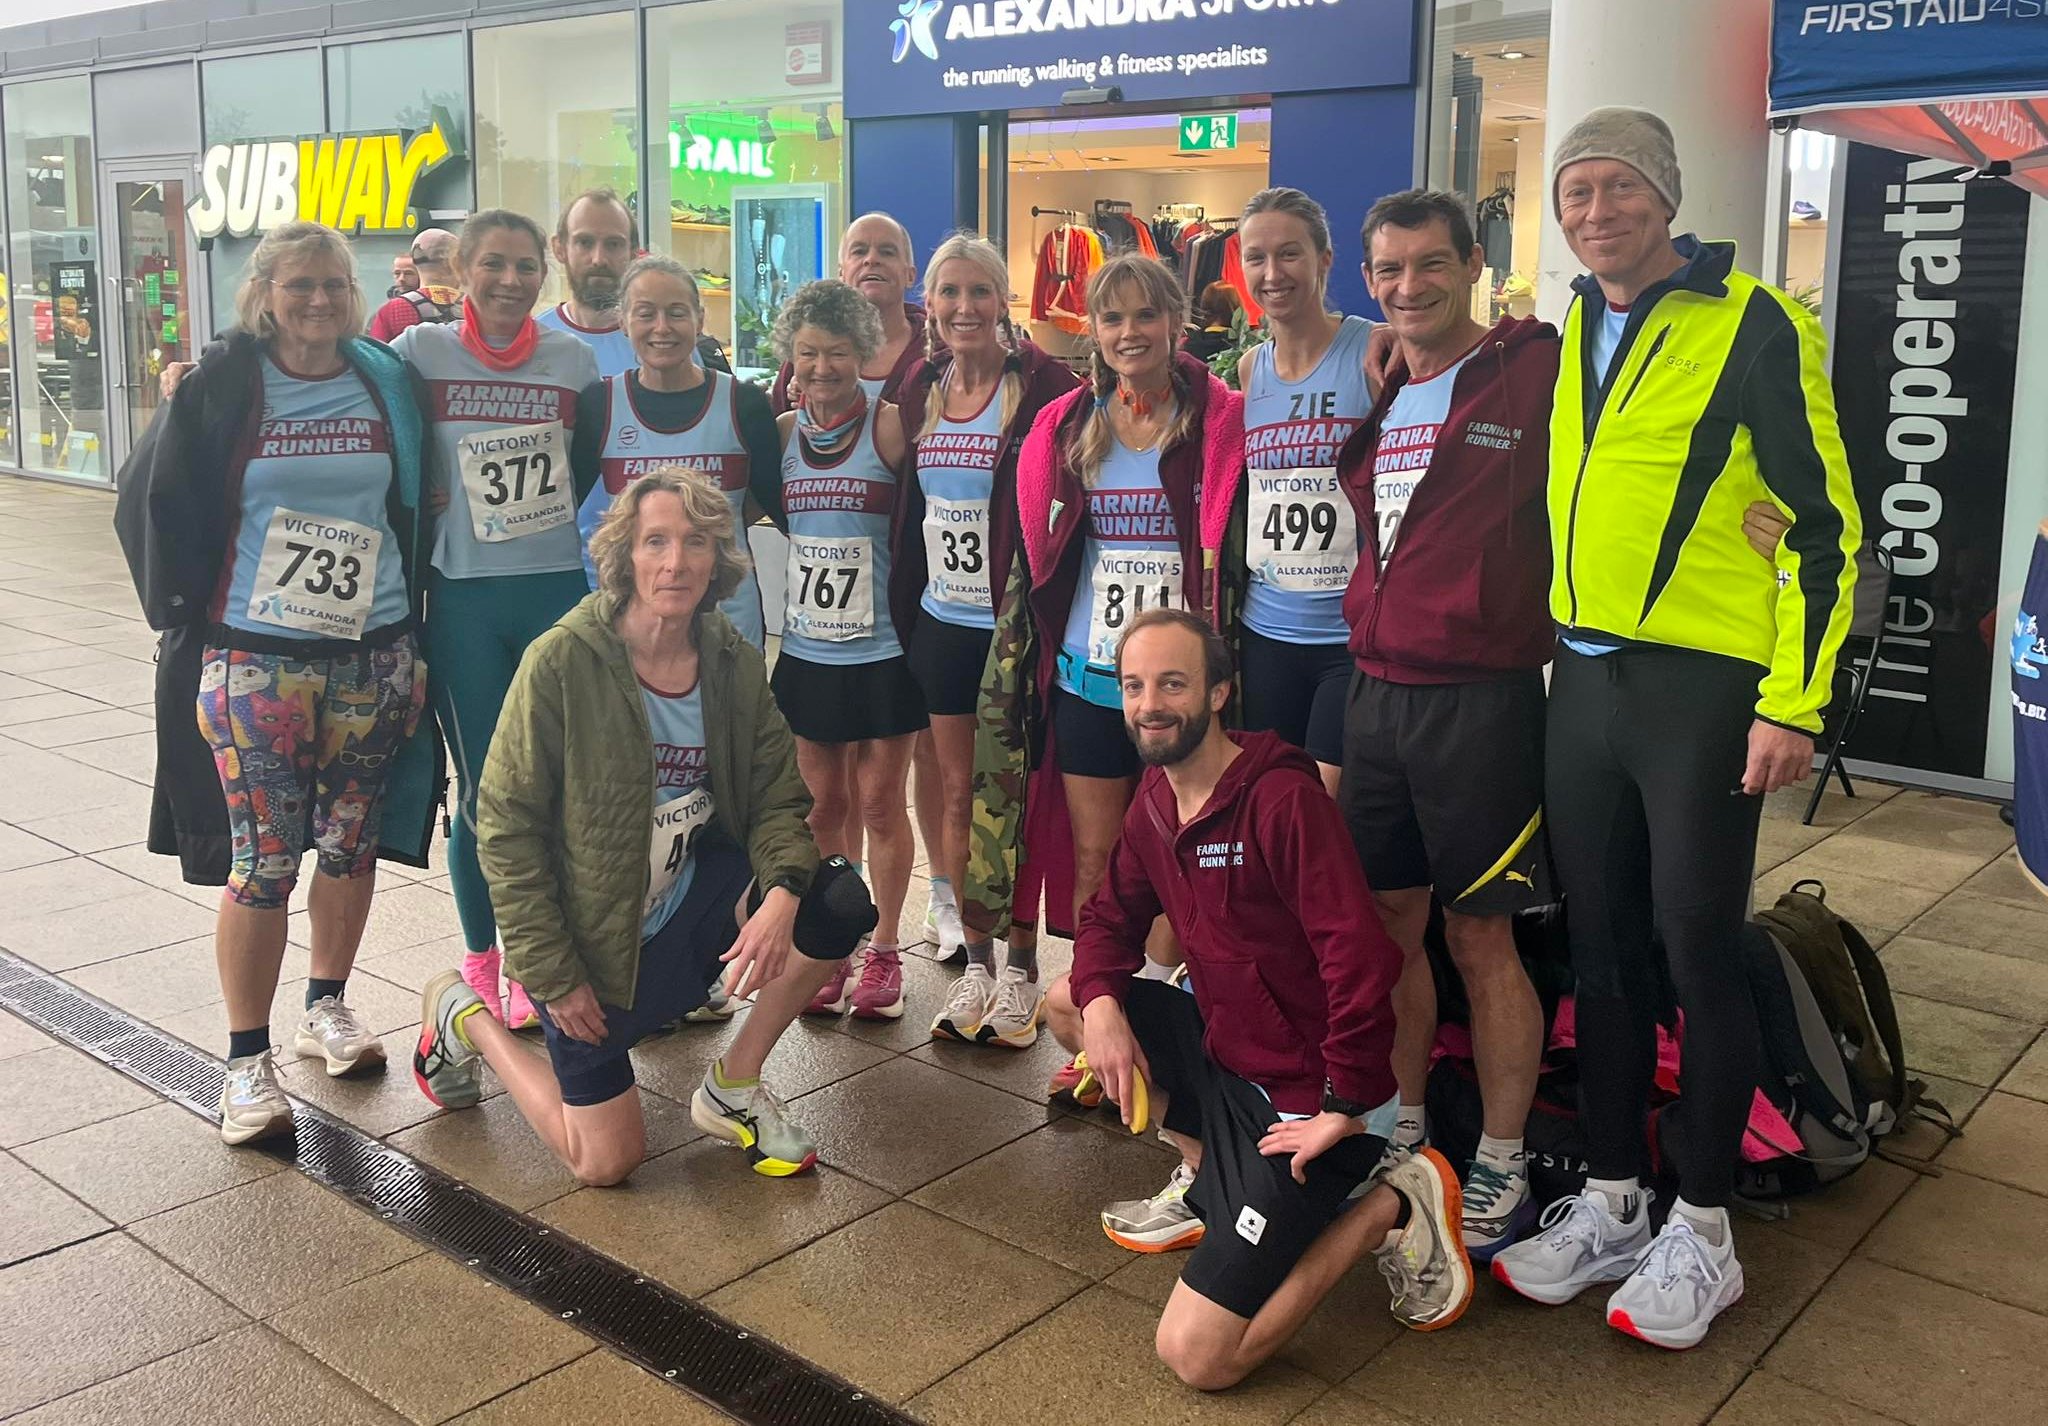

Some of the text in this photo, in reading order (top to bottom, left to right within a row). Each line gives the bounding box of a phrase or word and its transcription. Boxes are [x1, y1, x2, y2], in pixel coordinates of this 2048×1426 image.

[945, 0, 1196, 39] ALEXANDRA
[1800, 0, 2048, 35] FIRSTAID4S
[943, 44, 1268, 88] the running, walking & fitness specialists
[1667, 355, 1700, 371] GORE
[447, 384, 559, 405] FARNHAM
[447, 401, 558, 420] RUNNERS
[1288, 391, 1336, 421] ZIE
[258, 420, 371, 437] FARNHAM
[262, 437, 372, 456] RUNNERS
[468, 432, 552, 455] VICTORY 5
[917, 452, 995, 468] RUNNERS
[1374, 449, 1434, 474] RUNNER
[480, 452, 557, 506] 372
[785, 479, 867, 496] FARNHAM
[1260, 478, 1338, 492] VICTORY 5
[787, 495, 865, 511] RUNNERS
[1090, 493, 1172, 514] ARNHA
[505, 504, 567, 525] ALEXANDRA
[539, 513, 569, 528] SPORTS
[934, 505, 983, 522] VICTORY
[284, 518, 371, 550] VICTORY 5
[1091, 516, 1178, 536] RUNNER
[1262, 501, 1338, 551] 499
[852, 547, 861, 559] 5
[942, 530, 983, 574] 33
[275, 541, 362, 601] 733
[1102, 560, 1180, 576] VICTORY 5
[1276, 565, 1349, 575] ALEXANDRA
[798, 564, 860, 609] 767
[946, 585, 989, 594] ALEXAND
[1313, 577, 1349, 587] SPORTS
[284, 604, 356, 626] ALEXANDRA
[807, 619, 866, 630] ALEXANDRA
[319, 623, 353, 636] SPORTS
[1199, 854, 1243, 868] RUNNRS
[1525, 1150, 1589, 1173] PSTA
